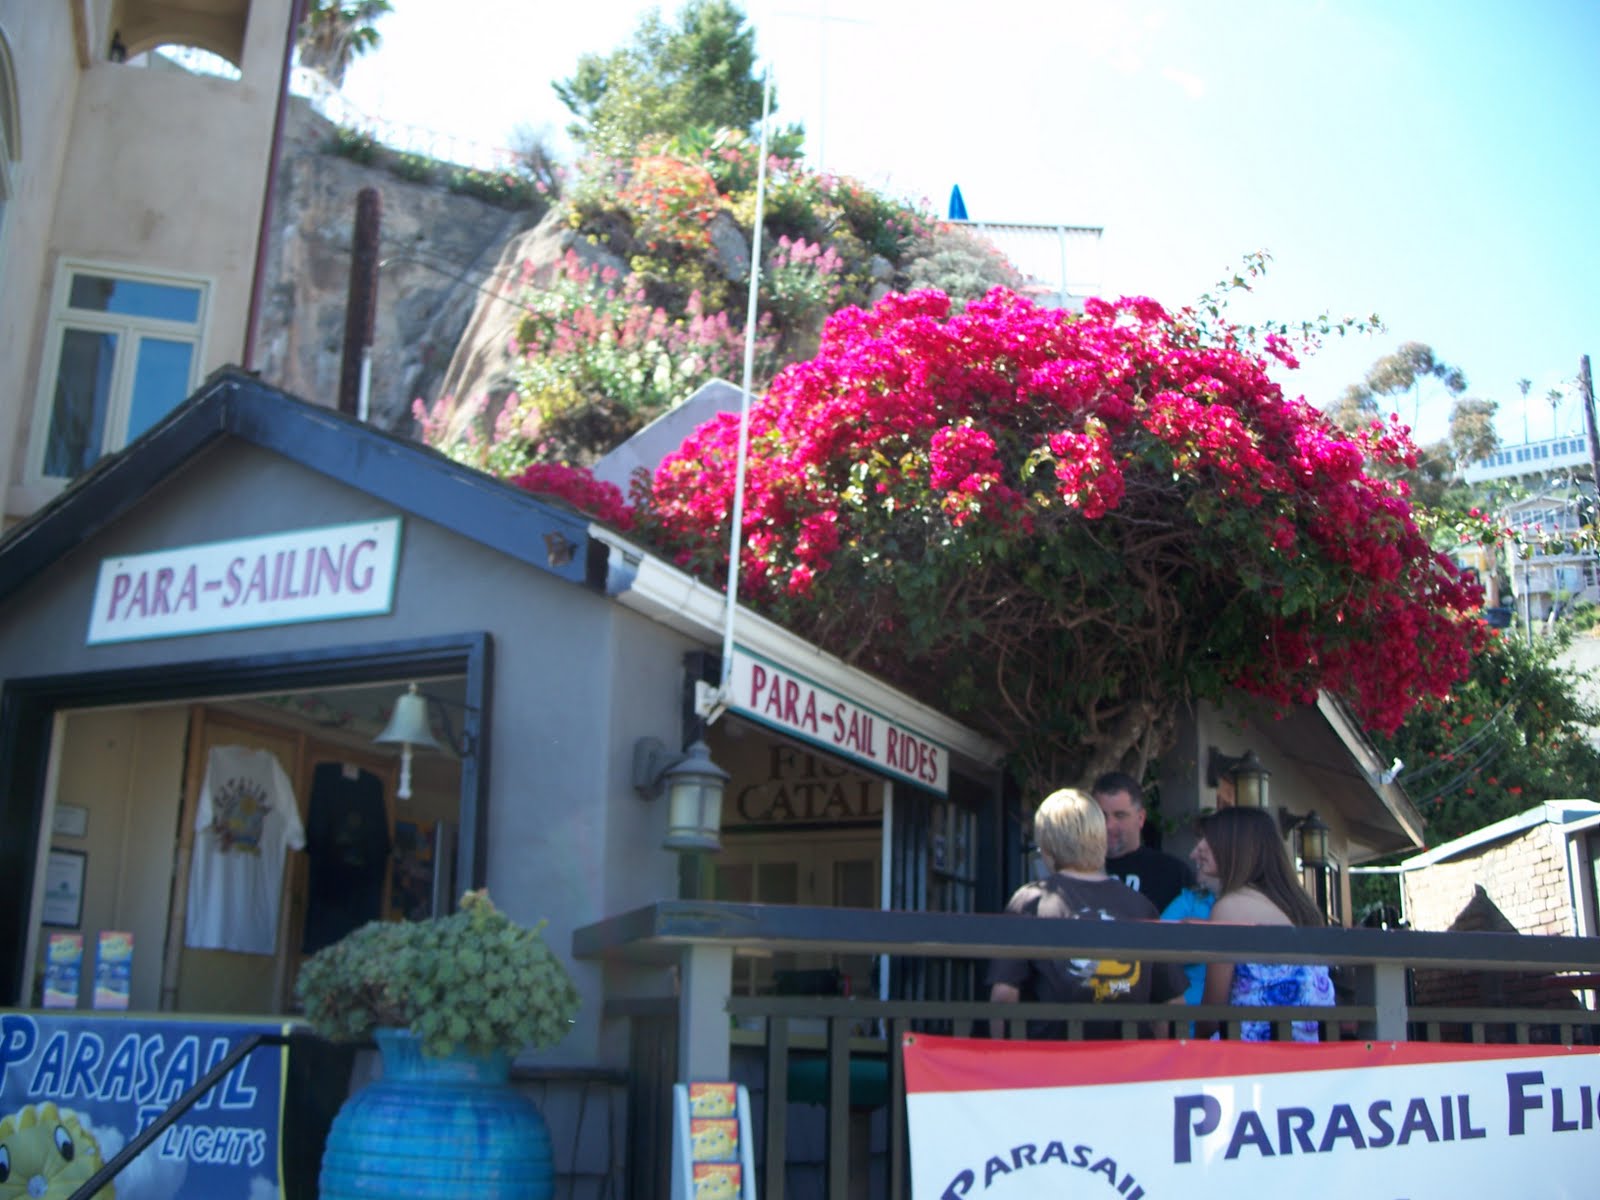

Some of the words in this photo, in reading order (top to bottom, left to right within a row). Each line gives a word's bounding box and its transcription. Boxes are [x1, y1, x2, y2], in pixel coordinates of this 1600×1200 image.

[106, 539, 378, 622] PARA-SAILING
[750, 664, 877, 758] PARA-SAIL
[886, 727, 938, 784] RIDES
[0, 1012, 257, 1110] PARASAIL
[1172, 1093, 1487, 1164] PARASAIL
[1506, 1071, 1600, 1136] FLI
